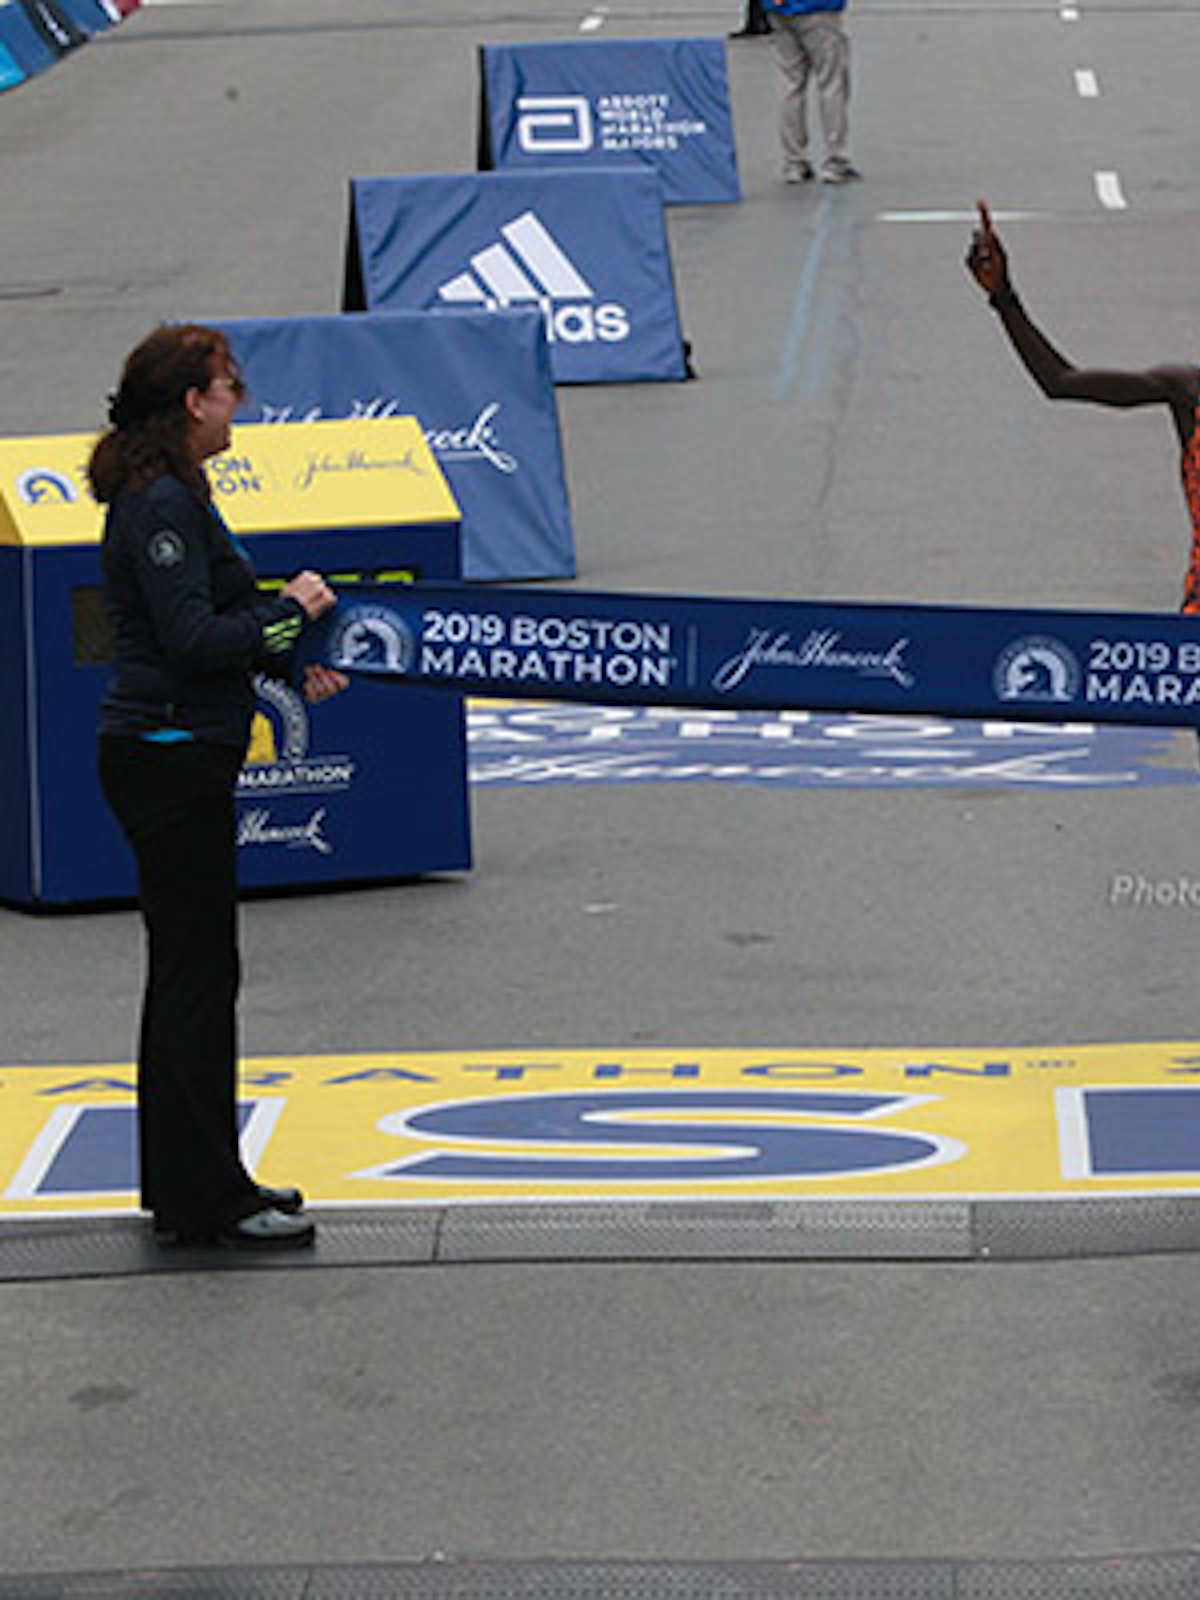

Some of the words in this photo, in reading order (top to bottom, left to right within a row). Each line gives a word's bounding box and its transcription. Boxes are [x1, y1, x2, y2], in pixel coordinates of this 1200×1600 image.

[602, 109, 666, 121] WORLD
[602, 121, 706, 135] MARATHON
[421, 610, 504, 646] 2019
[509, 617, 671, 652] BOSTON
[420, 647, 671, 687] MARATHON
[711, 627, 798, 694] John
[799, 628, 916, 688] Hancock
[1089, 641, 1171, 671] 2019
